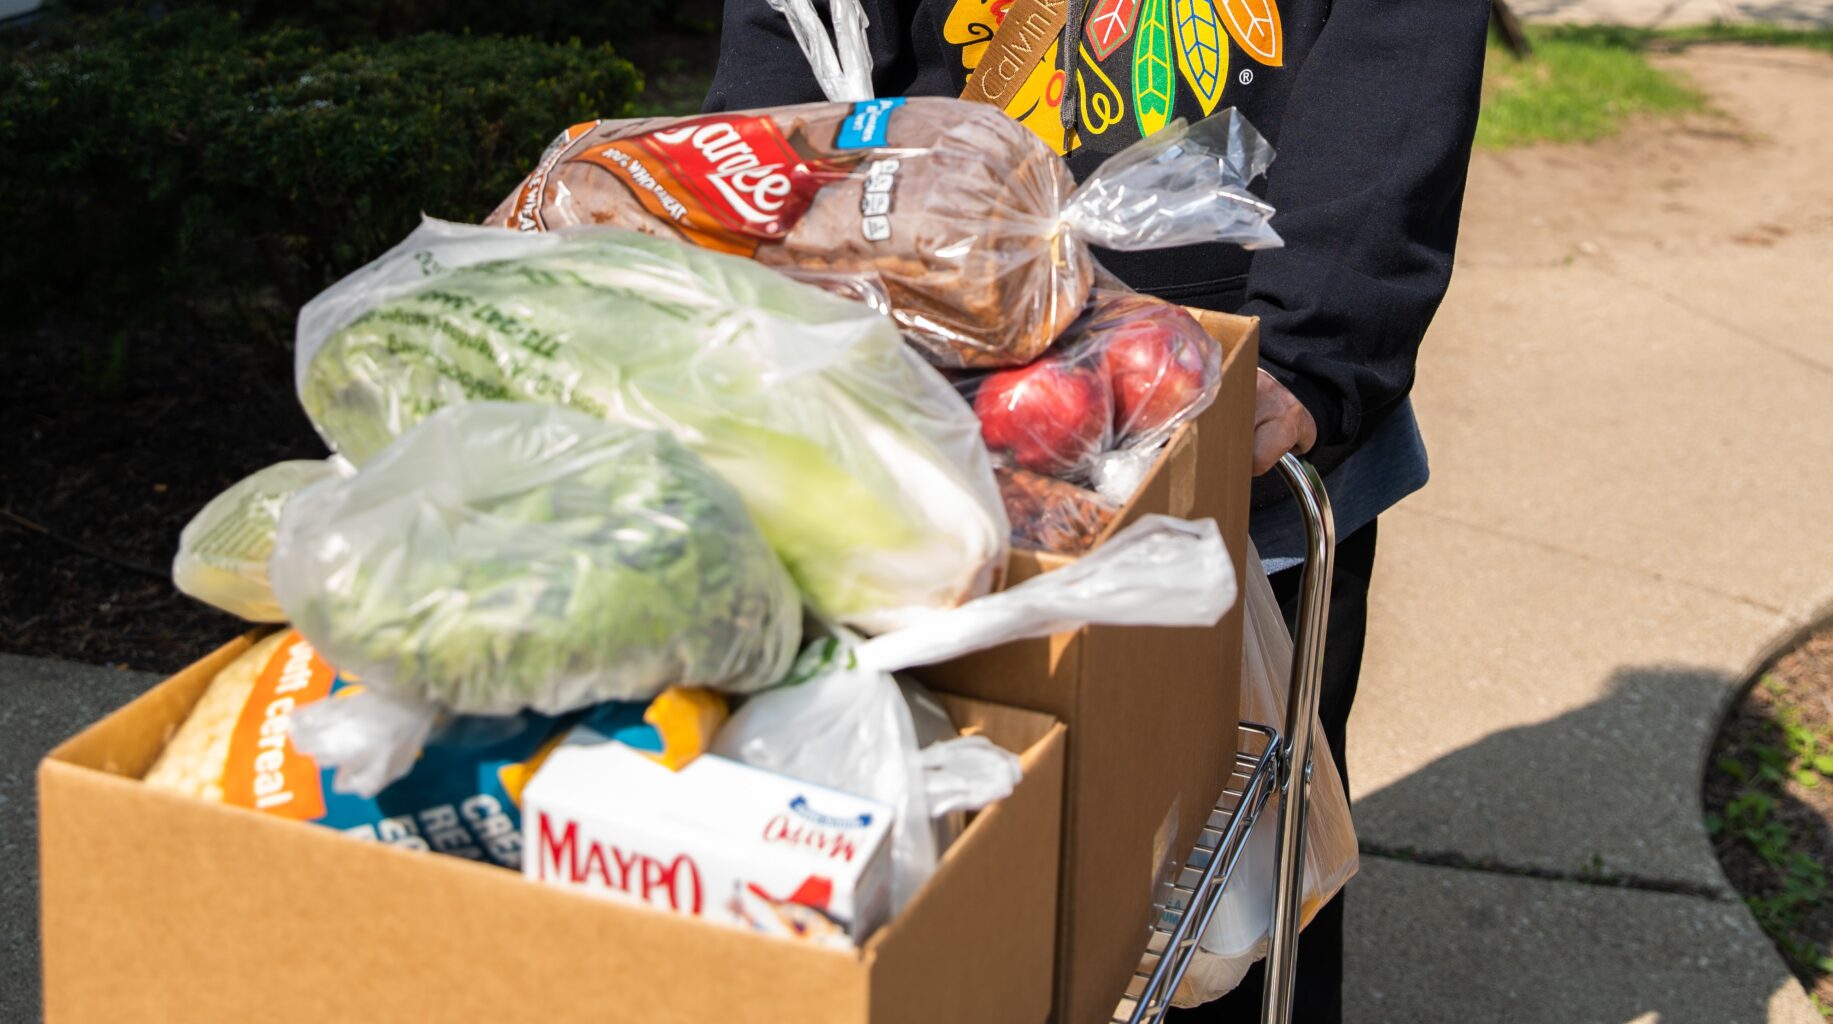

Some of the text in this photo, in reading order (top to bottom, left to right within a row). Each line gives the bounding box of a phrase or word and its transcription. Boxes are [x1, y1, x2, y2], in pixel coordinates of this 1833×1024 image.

[982, 11, 1051, 100] Calvin
[252, 696, 296, 810] cereal
[538, 809, 704, 919] MAYPO
